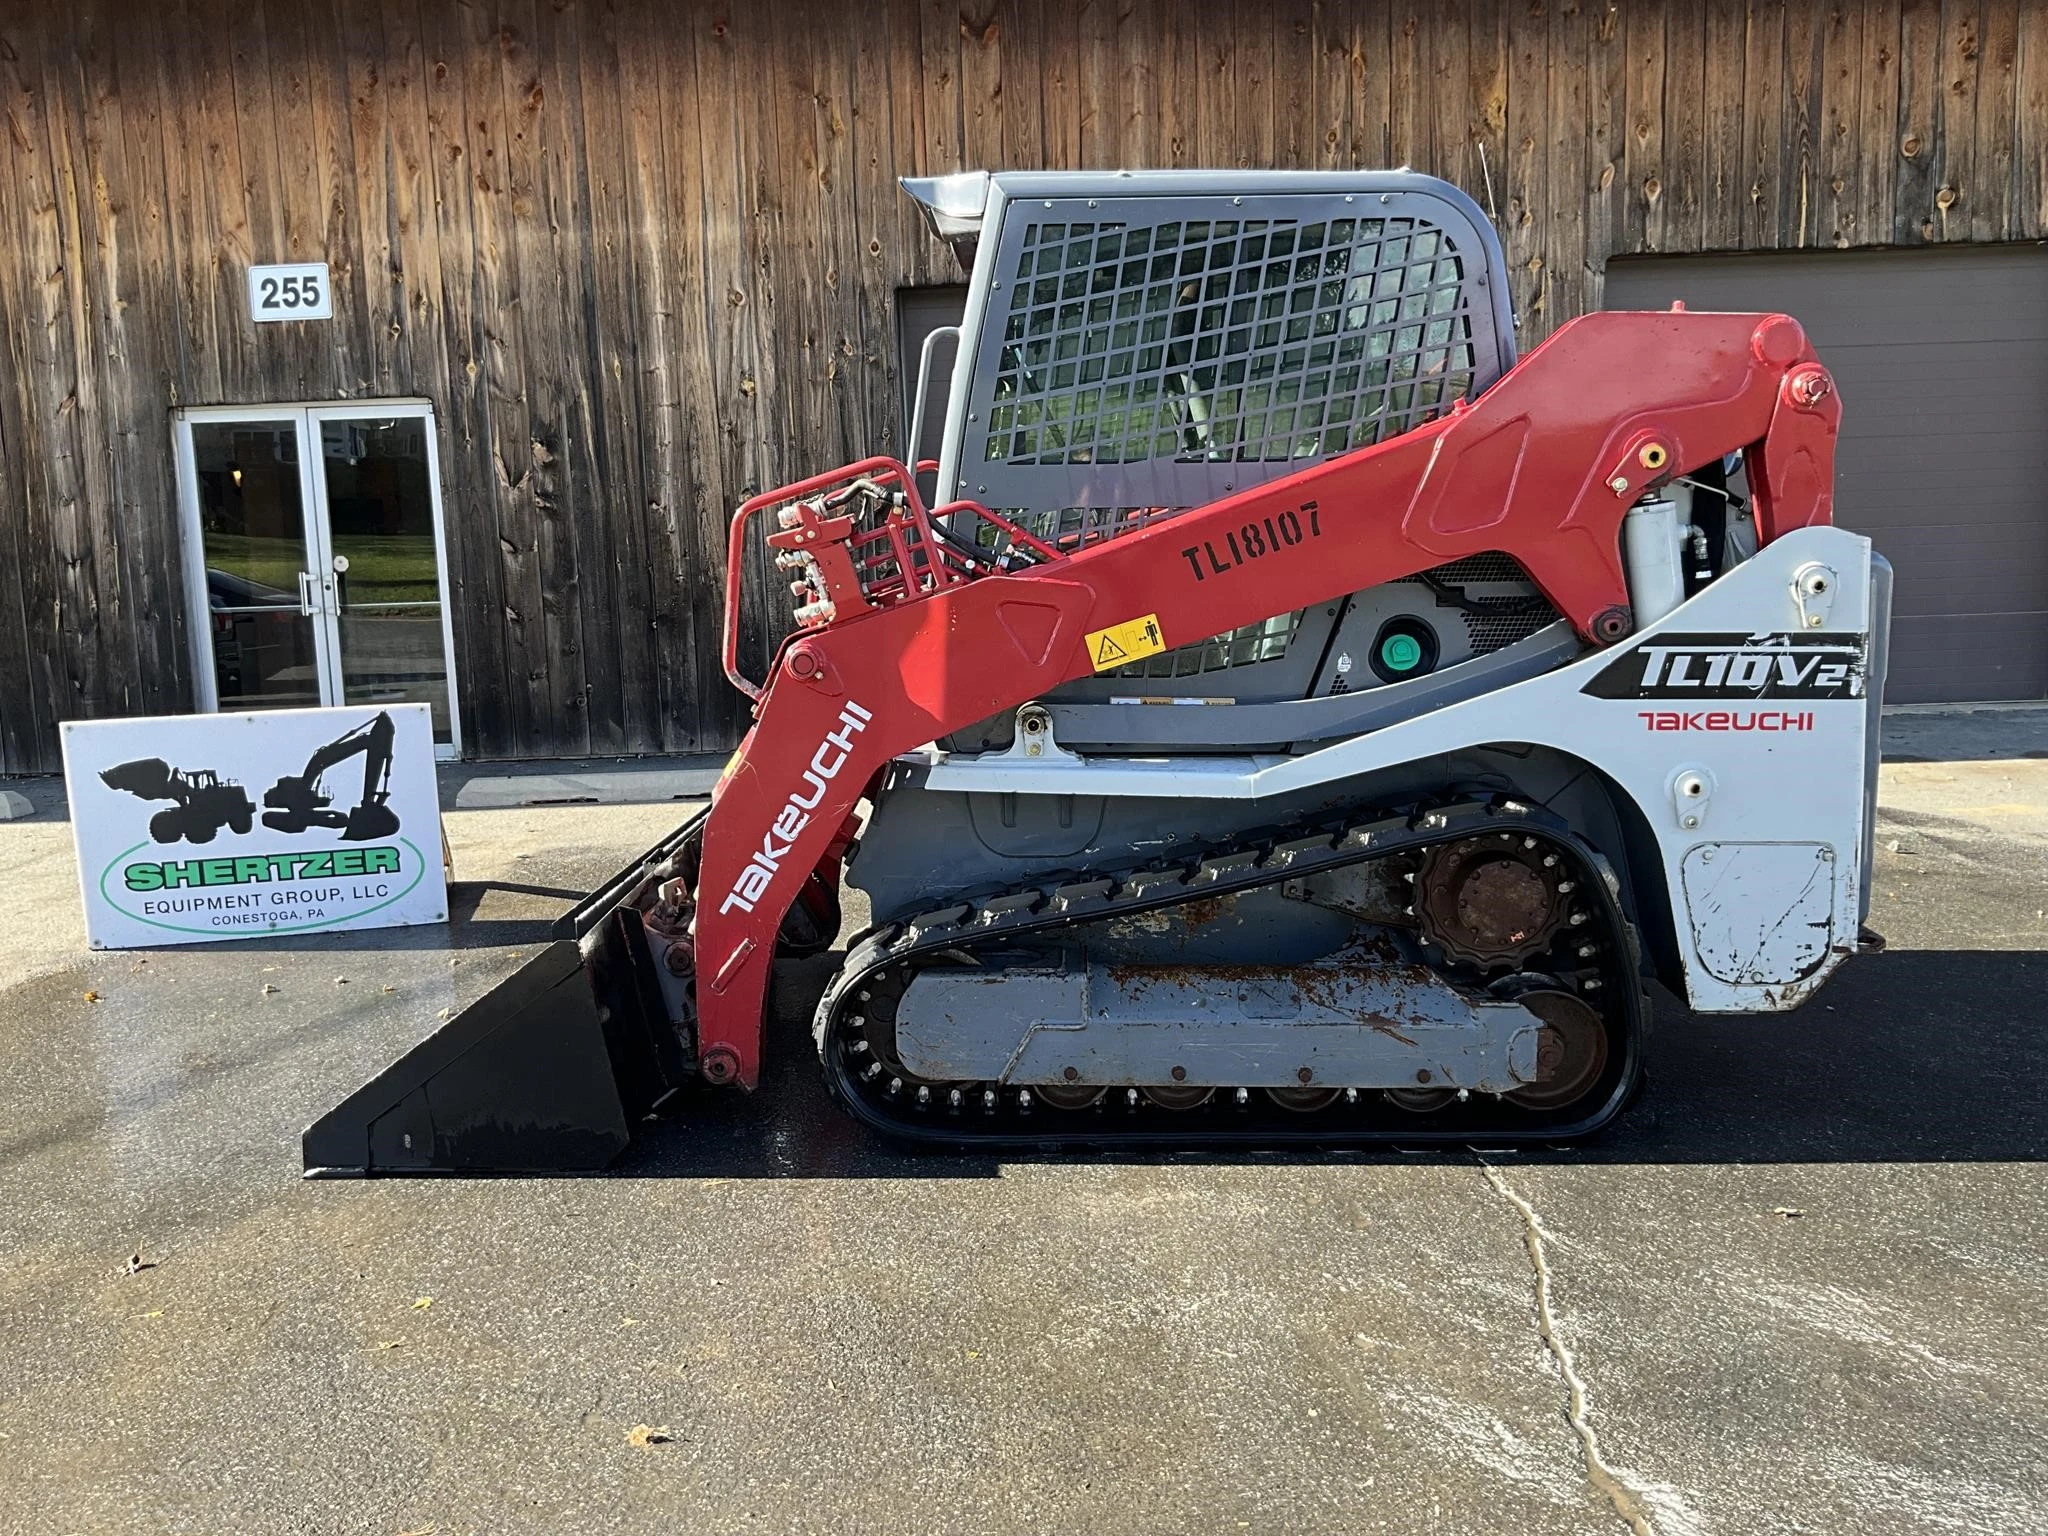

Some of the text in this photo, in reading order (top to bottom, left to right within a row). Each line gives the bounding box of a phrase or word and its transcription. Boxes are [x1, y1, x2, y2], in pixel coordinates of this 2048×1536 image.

[261, 276, 320, 309] 255
[124, 846, 401, 892] SHERTZER
[144, 884, 390, 915] EQUIPMENT GROUP, LLC
[211, 908, 325, 926] CONESTOGA, PA
